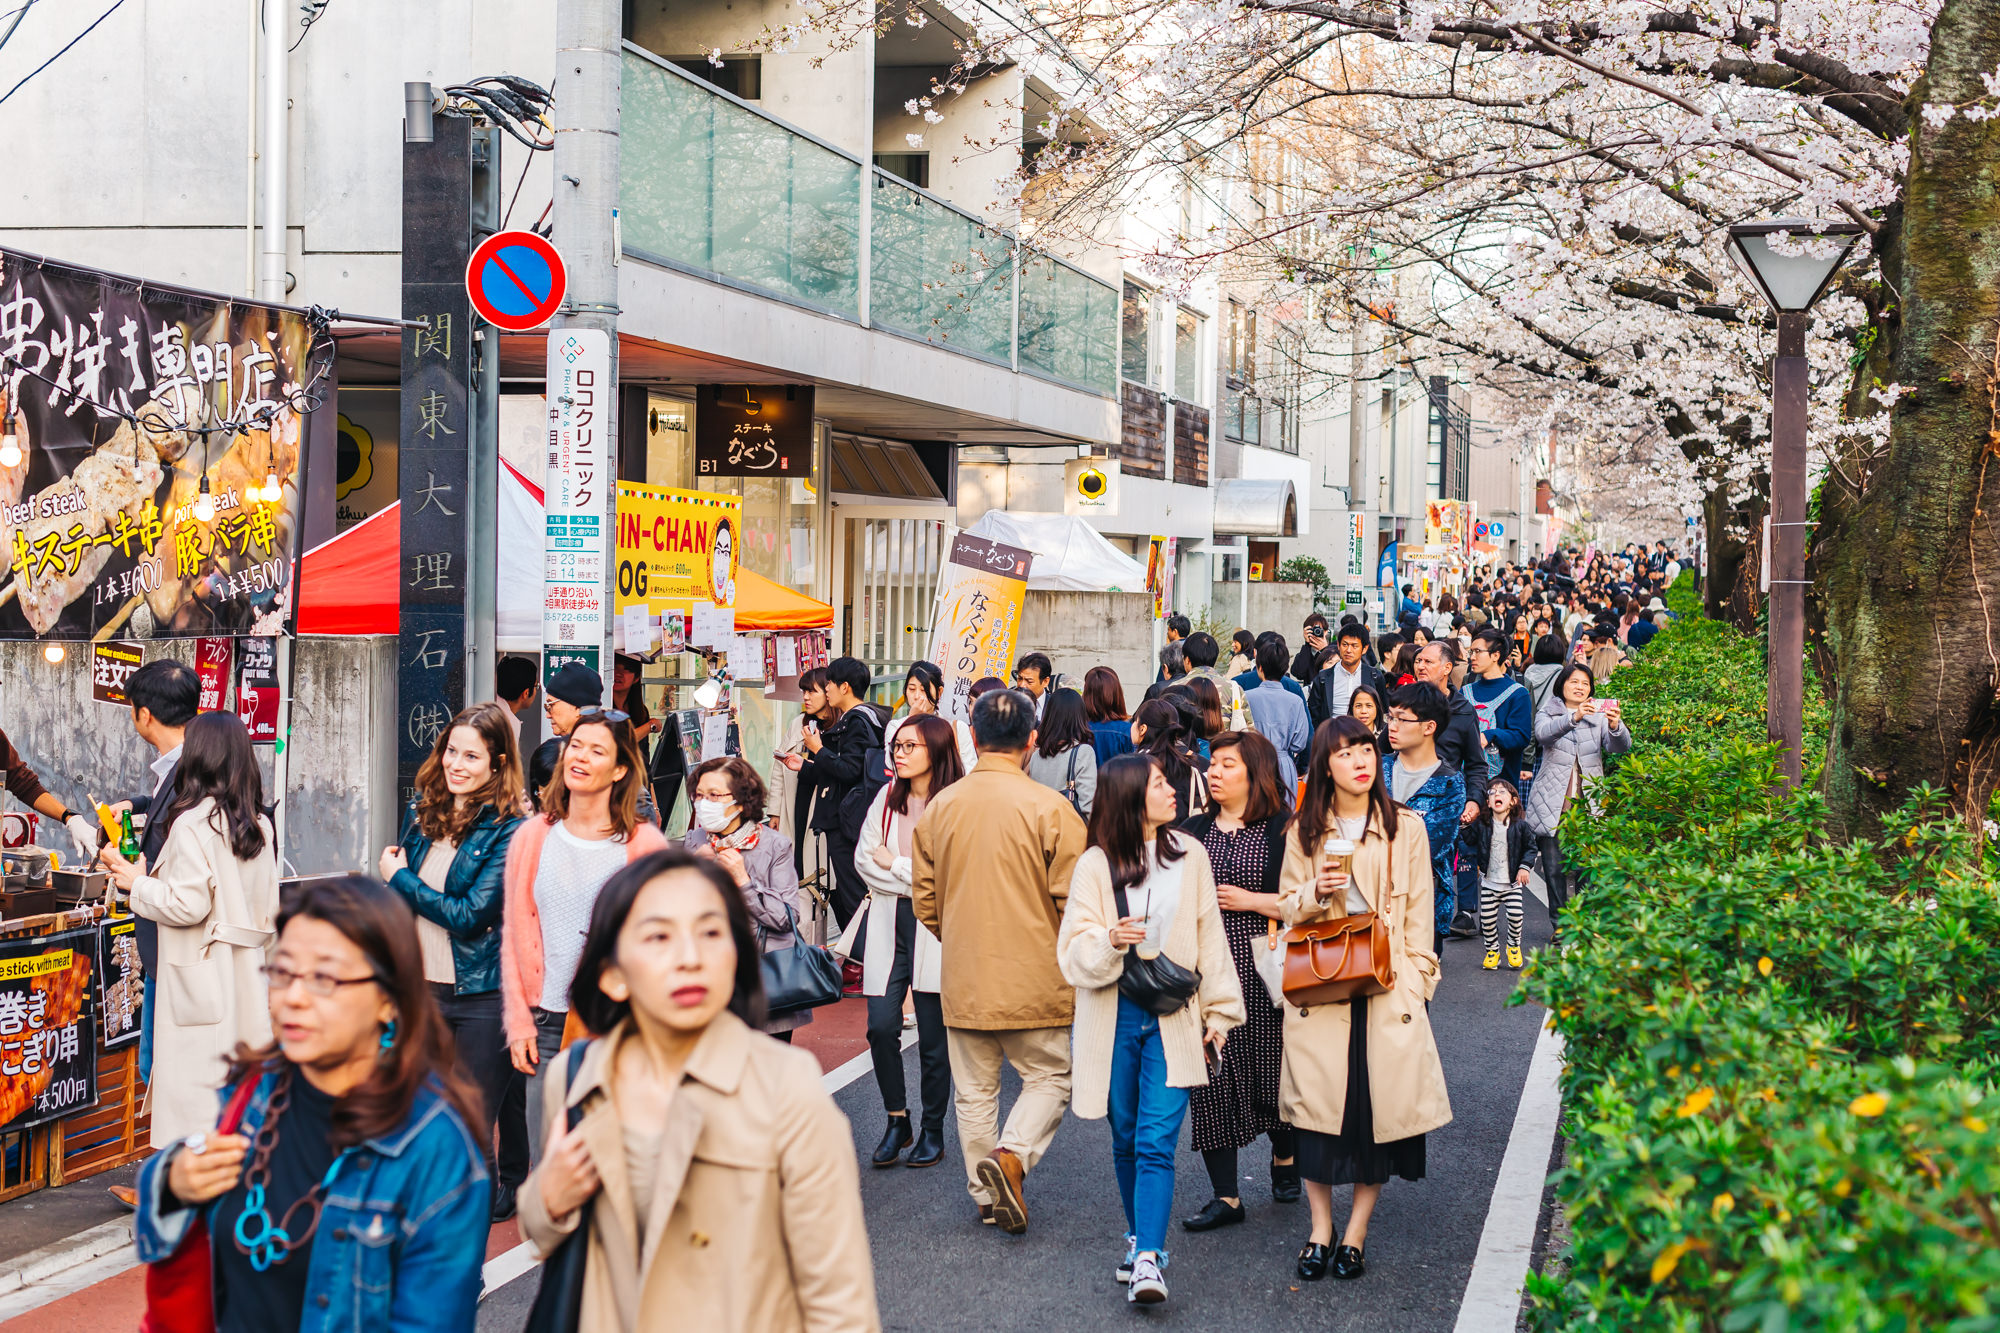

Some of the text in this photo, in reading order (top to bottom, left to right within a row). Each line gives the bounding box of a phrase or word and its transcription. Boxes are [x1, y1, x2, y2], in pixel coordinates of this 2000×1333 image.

[0, 278, 278, 435] 串焼き専門店
[548, 407, 559, 469] 中目黒
[574, 370, 594, 507] ロコクリニック
[733, 423, 773, 434] ステーキ
[562, 431, 570, 475] URGENT
[700, 459, 717, 472] B1
[728, 437, 778, 470] なぐら
[2, 486, 87, 526] beef steak
[561, 478, 569, 508] CARE
[11, 499, 164, 592] 牛ステーキ串
[175, 503, 277, 579] 豚バラ串
[615, 512, 708, 554] IN-CHAN
[956, 544, 985, 557] ステーキ
[986, 547, 1015, 571] なぐら
[615, 560, 648, 597] OG
[205, 643, 229, 663] ワイン
[7, 960, 35, 976] stick
[37, 957, 51, 972] with
[53, 955, 70, 968] meat
[119, 935, 133, 1031] 牛ステーキ串
